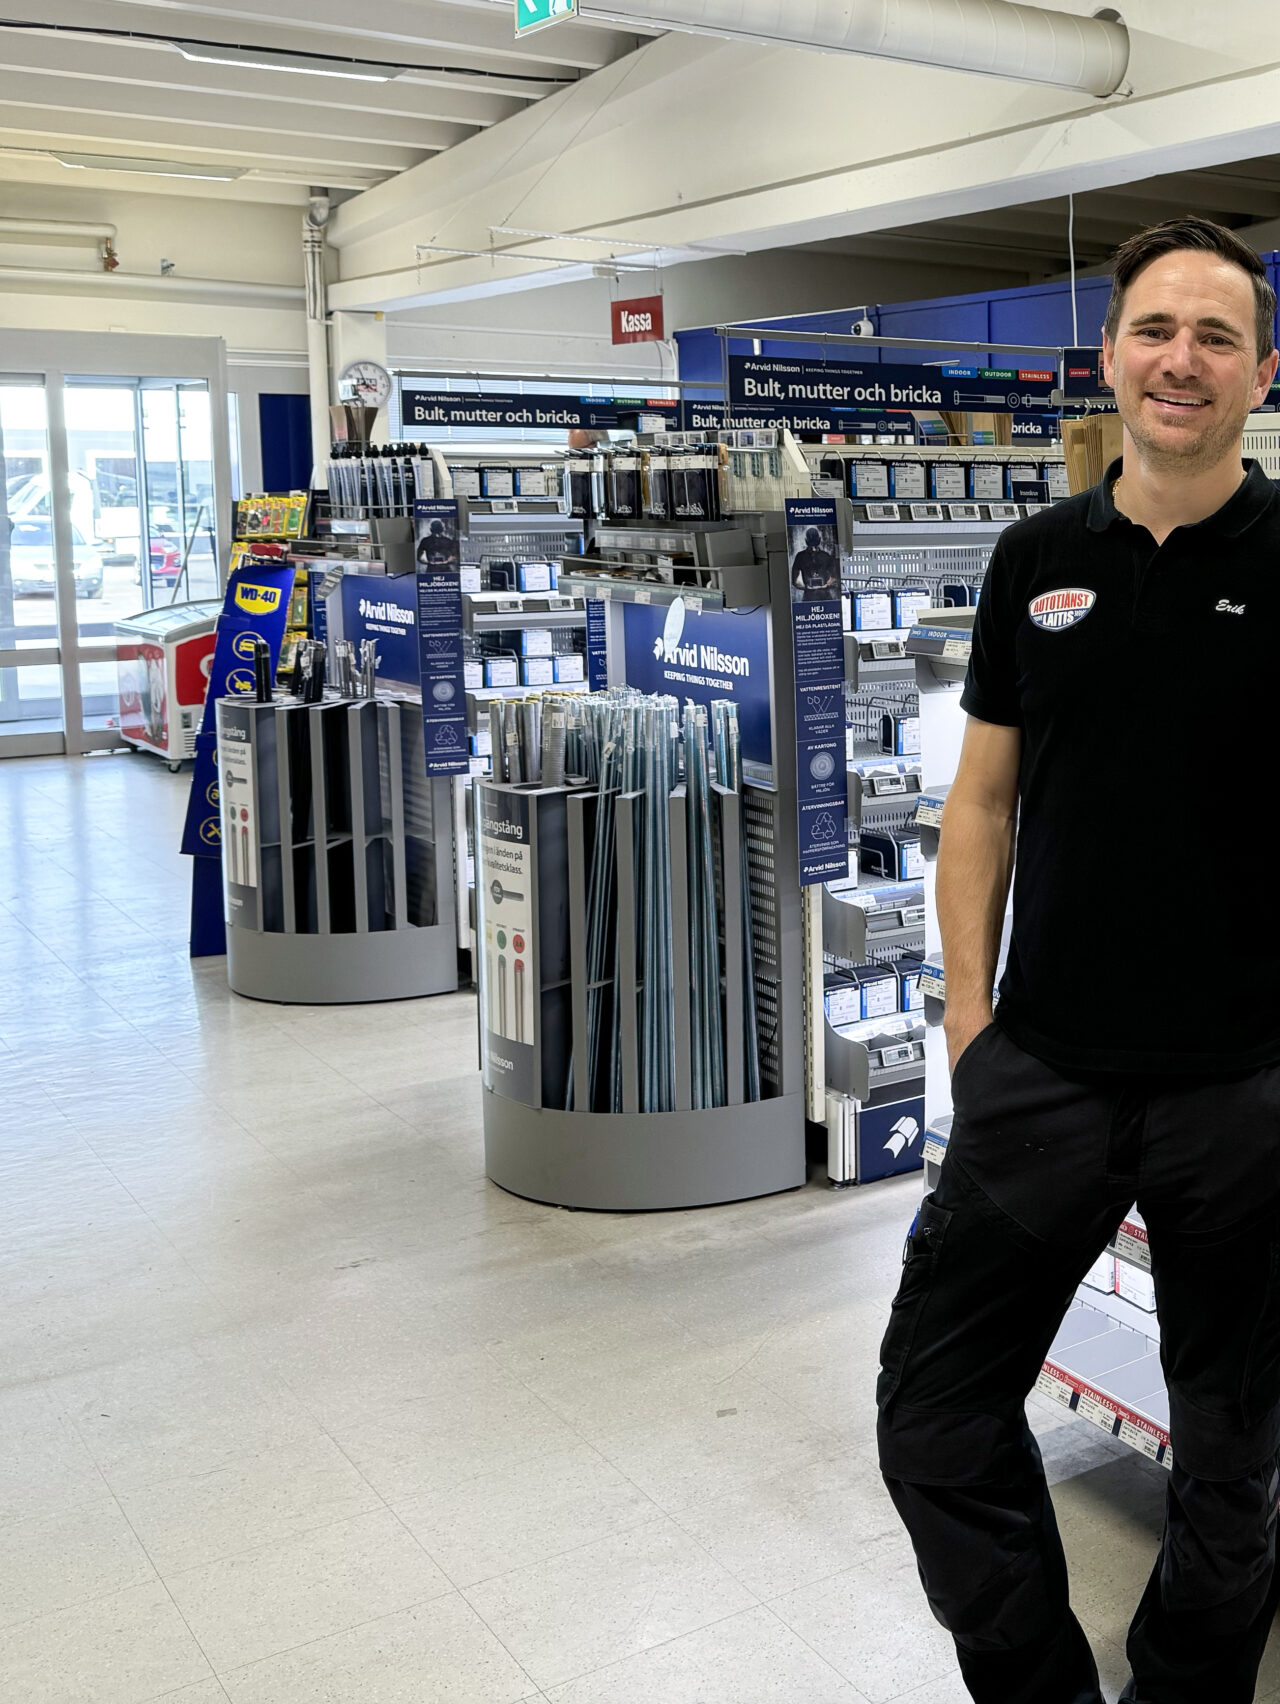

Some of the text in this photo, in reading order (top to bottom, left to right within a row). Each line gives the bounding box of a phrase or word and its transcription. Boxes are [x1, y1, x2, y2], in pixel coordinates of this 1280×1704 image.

[621, 311, 652, 333] Kassa
[744, 378, 942, 403] Bult, mutter och bricka
[414, 406, 580, 425] Bult, mutter och bricka
[692, 414, 830, 430] Bult, mutter och bricka
[1012, 419, 1042, 434] bricka
[240, 586, 276, 603] WD-40
[1033, 590, 1089, 613] AUTOTJÄNST
[366, 600, 414, 625] Arvid Nilsson
[1215, 599, 1244, 615] Erik
[795, 613, 840, 621] MILJÖBOXEN!
[1043, 611, 1074, 626] LAITIS
[800, 684, 841, 692] VATTENRESISTENT
[808, 861, 846, 873] Arvid Nilsson
